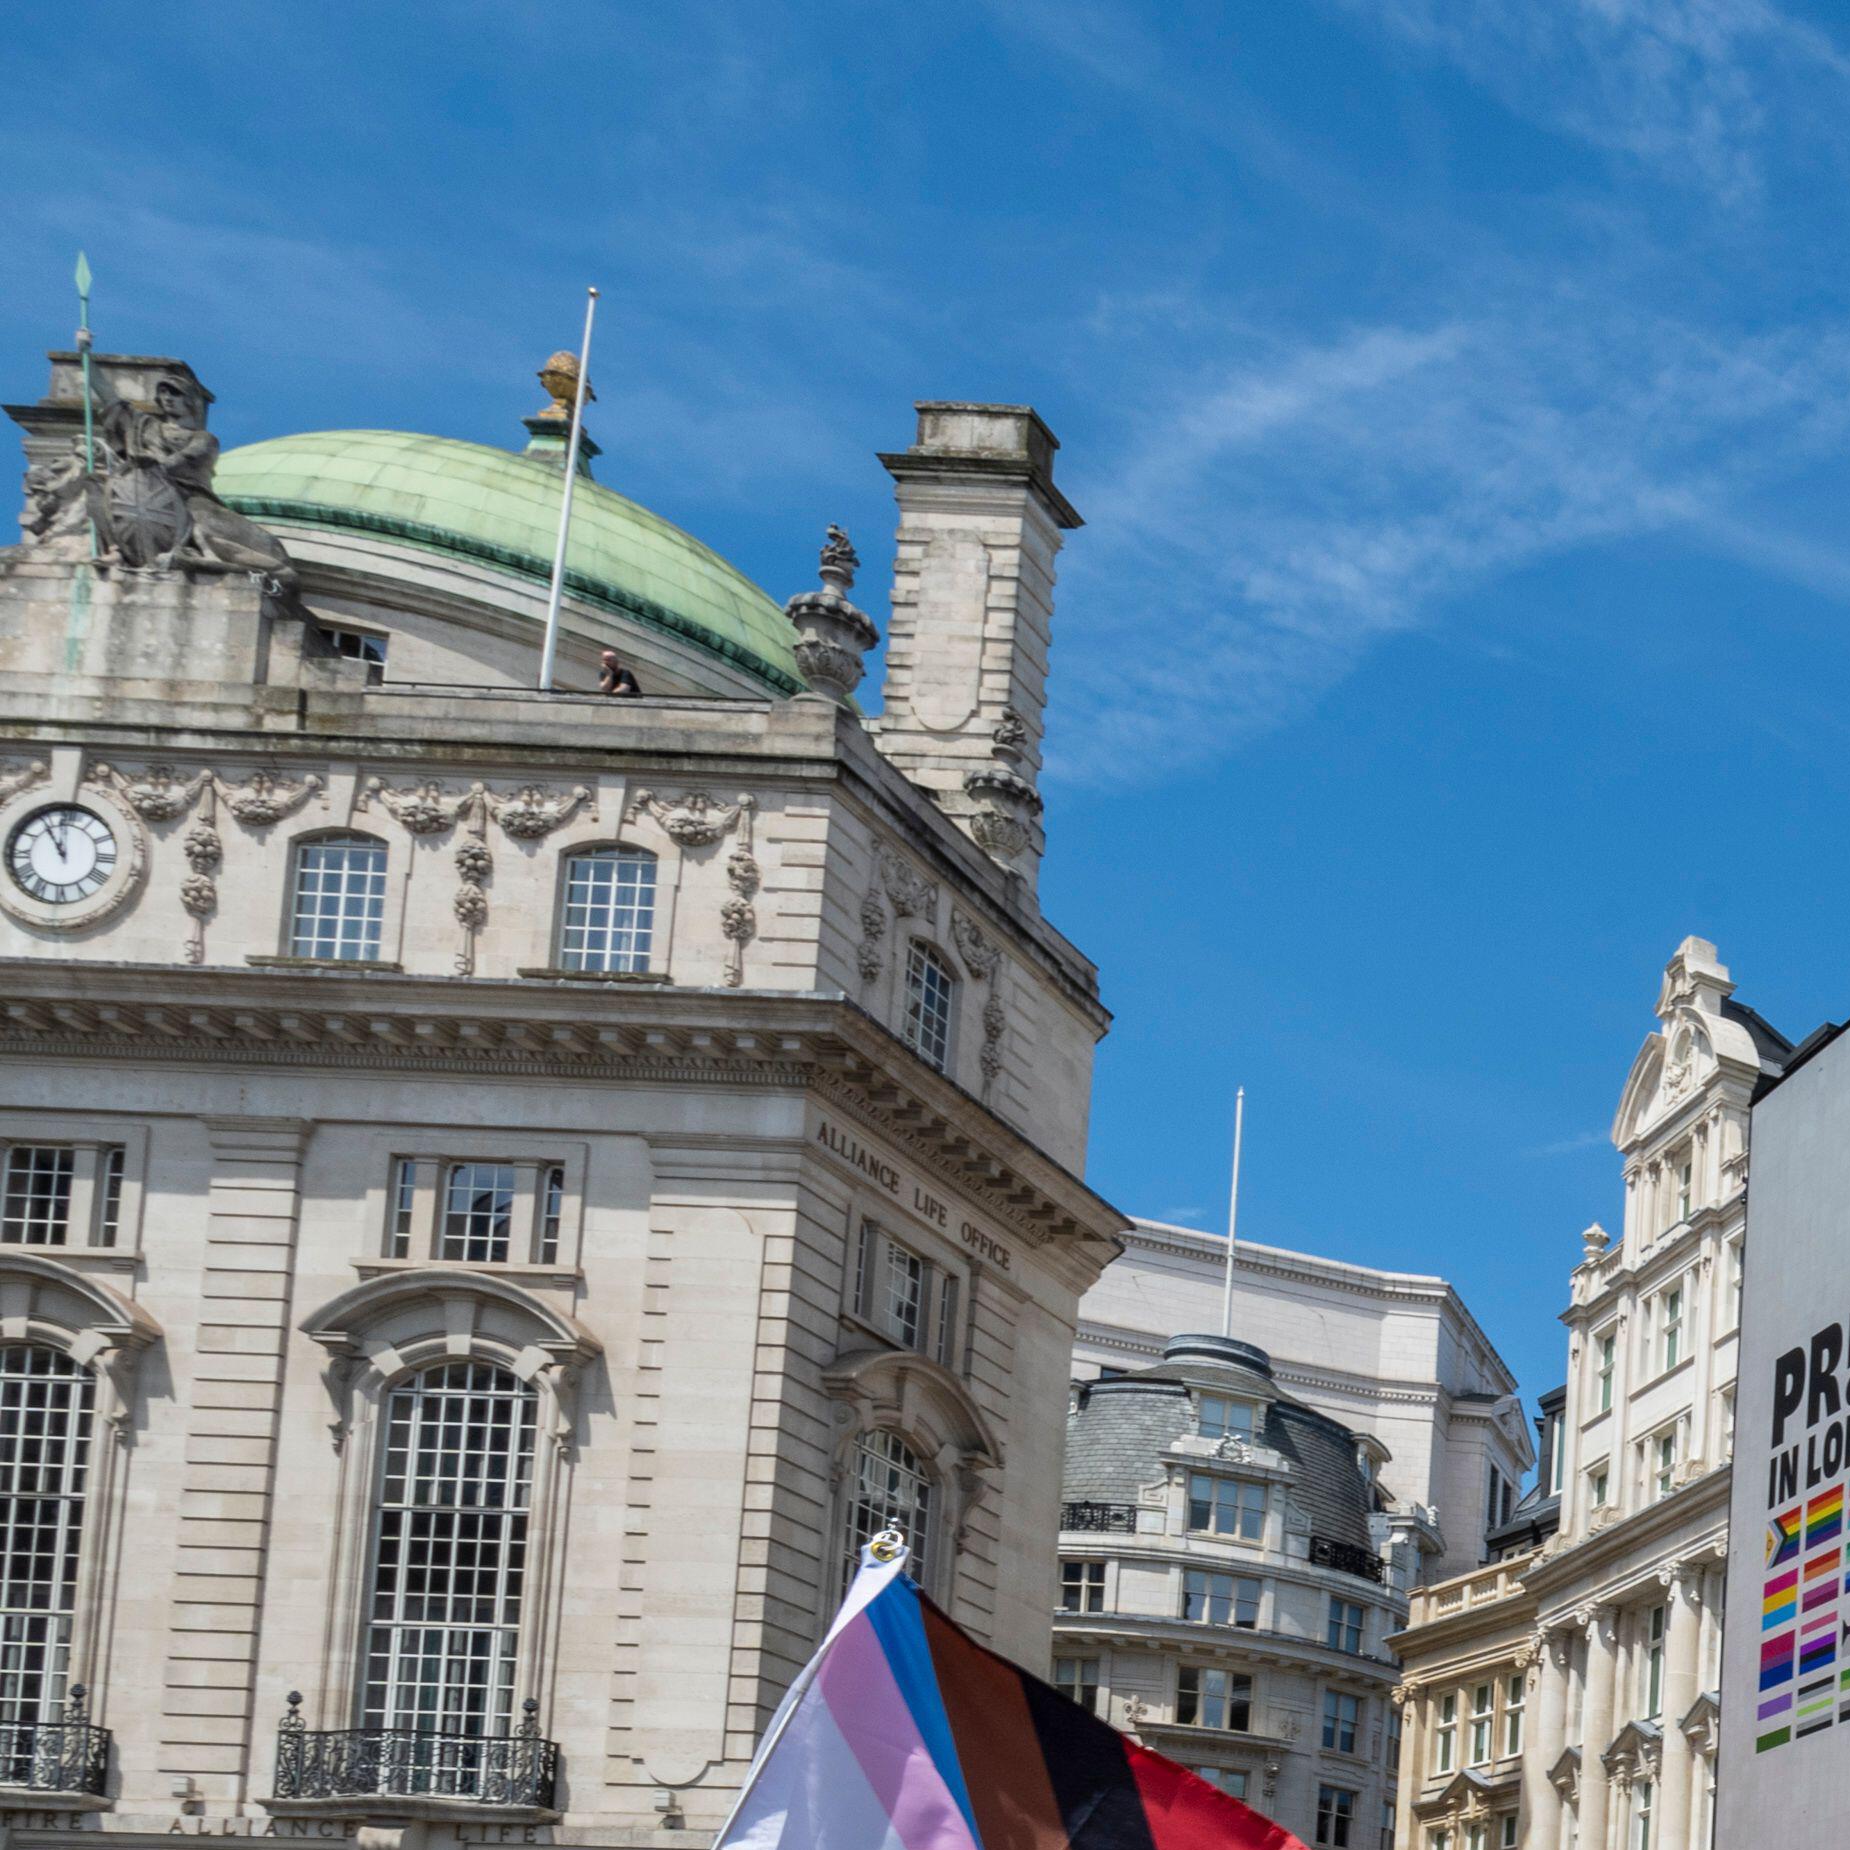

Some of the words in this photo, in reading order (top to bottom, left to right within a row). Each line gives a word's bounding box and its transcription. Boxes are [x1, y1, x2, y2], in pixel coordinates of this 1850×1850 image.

[817, 1122, 900, 1194] ALLIANCE
[914, 1187, 948, 1228] LIFE
[961, 1221, 1011, 1272] OFFICE
[1768, 1444, 1799, 1510] IN
